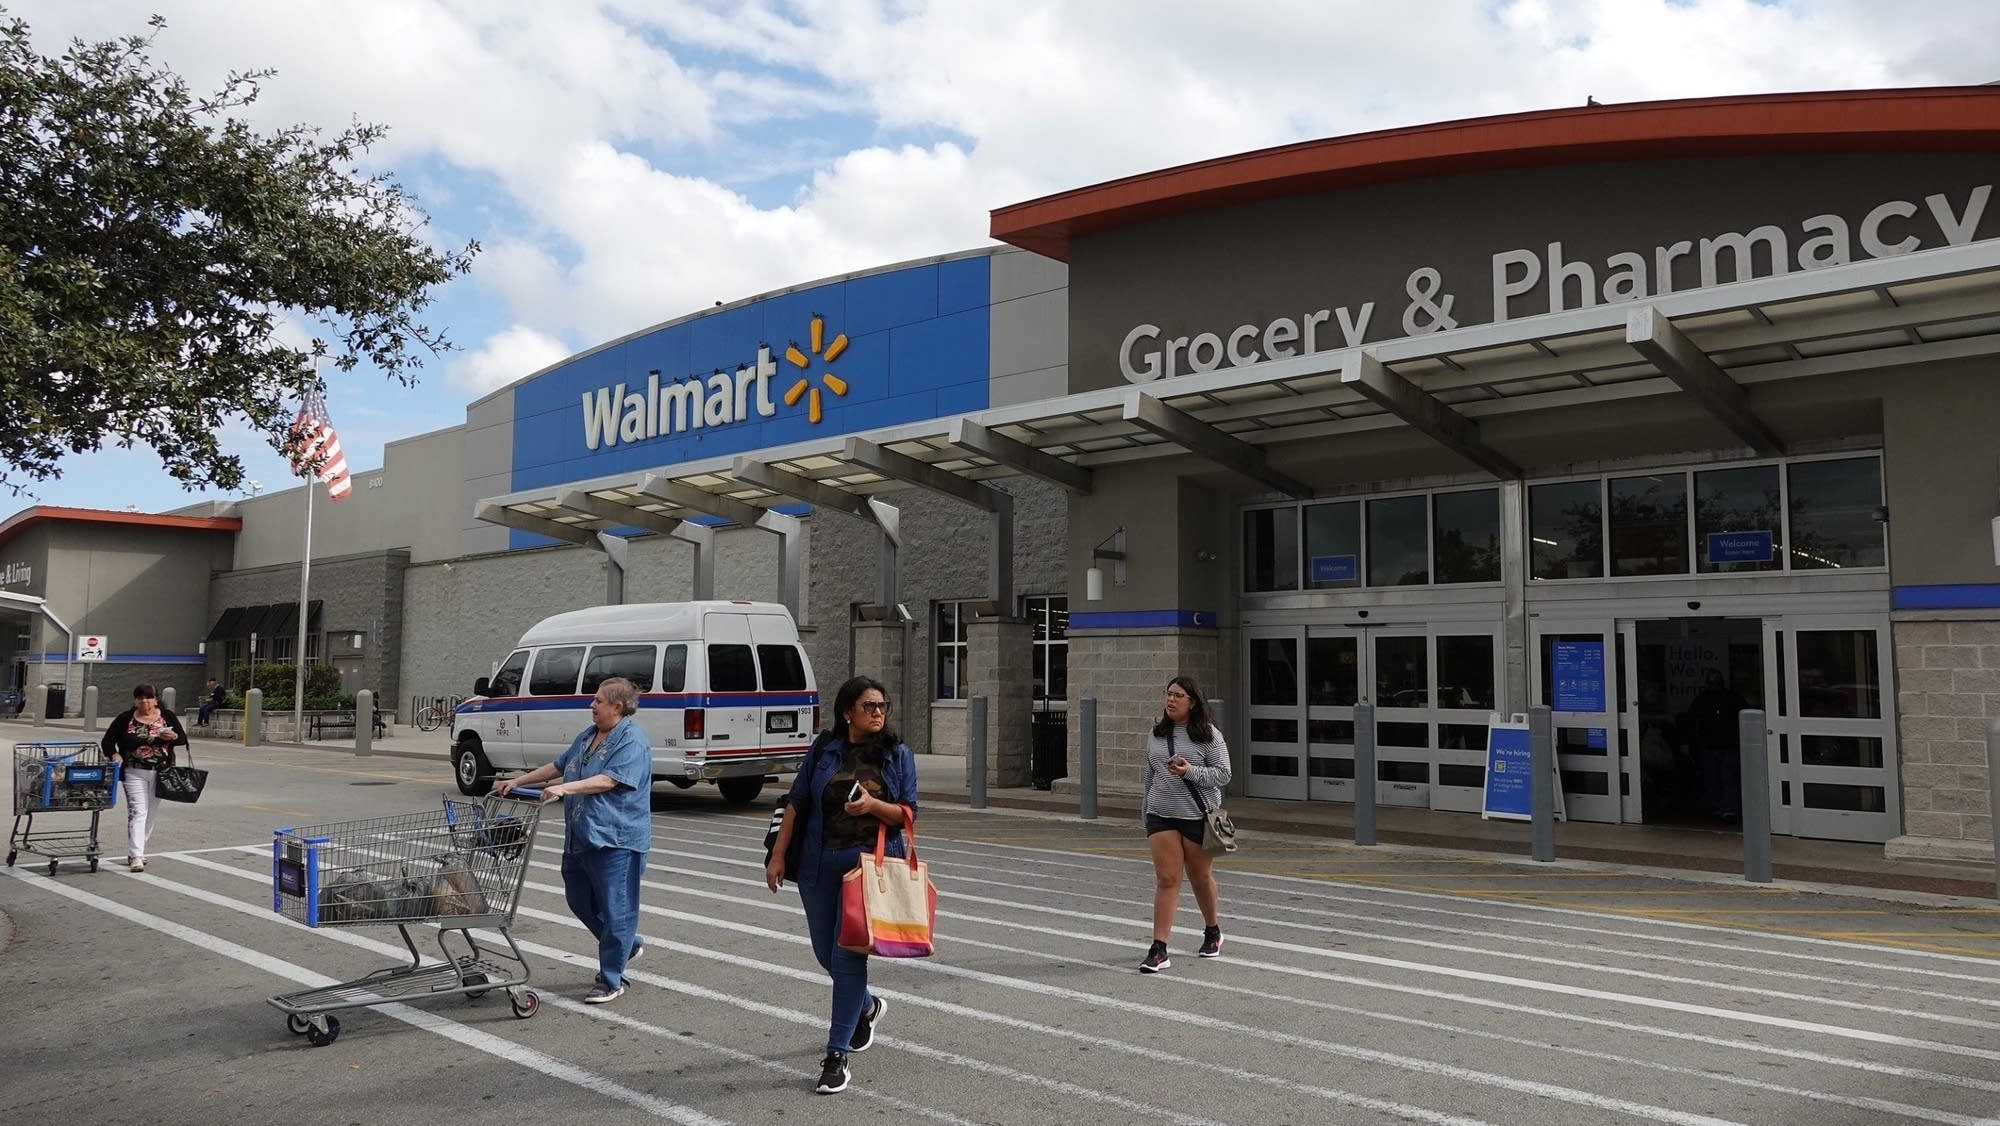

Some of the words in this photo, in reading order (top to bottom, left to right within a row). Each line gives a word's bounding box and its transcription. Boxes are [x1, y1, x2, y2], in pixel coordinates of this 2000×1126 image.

[1119, 302, 1376, 386] Grocery
[1402, 267, 1458, 337] &
[1492, 184, 1993, 323] Pharmacy
[582, 347, 776, 450] Walmart
[1720, 540, 1760, 549] Welcome
[12, 562, 31, 587] Living
[1669, 644, 1718, 661] Hello.
[798, 707, 811, 715] 1903
[665, 738, 677, 746] 1903
[1496, 748, 1512, 756] We're
[1513, 749, 1530, 758] hiring
